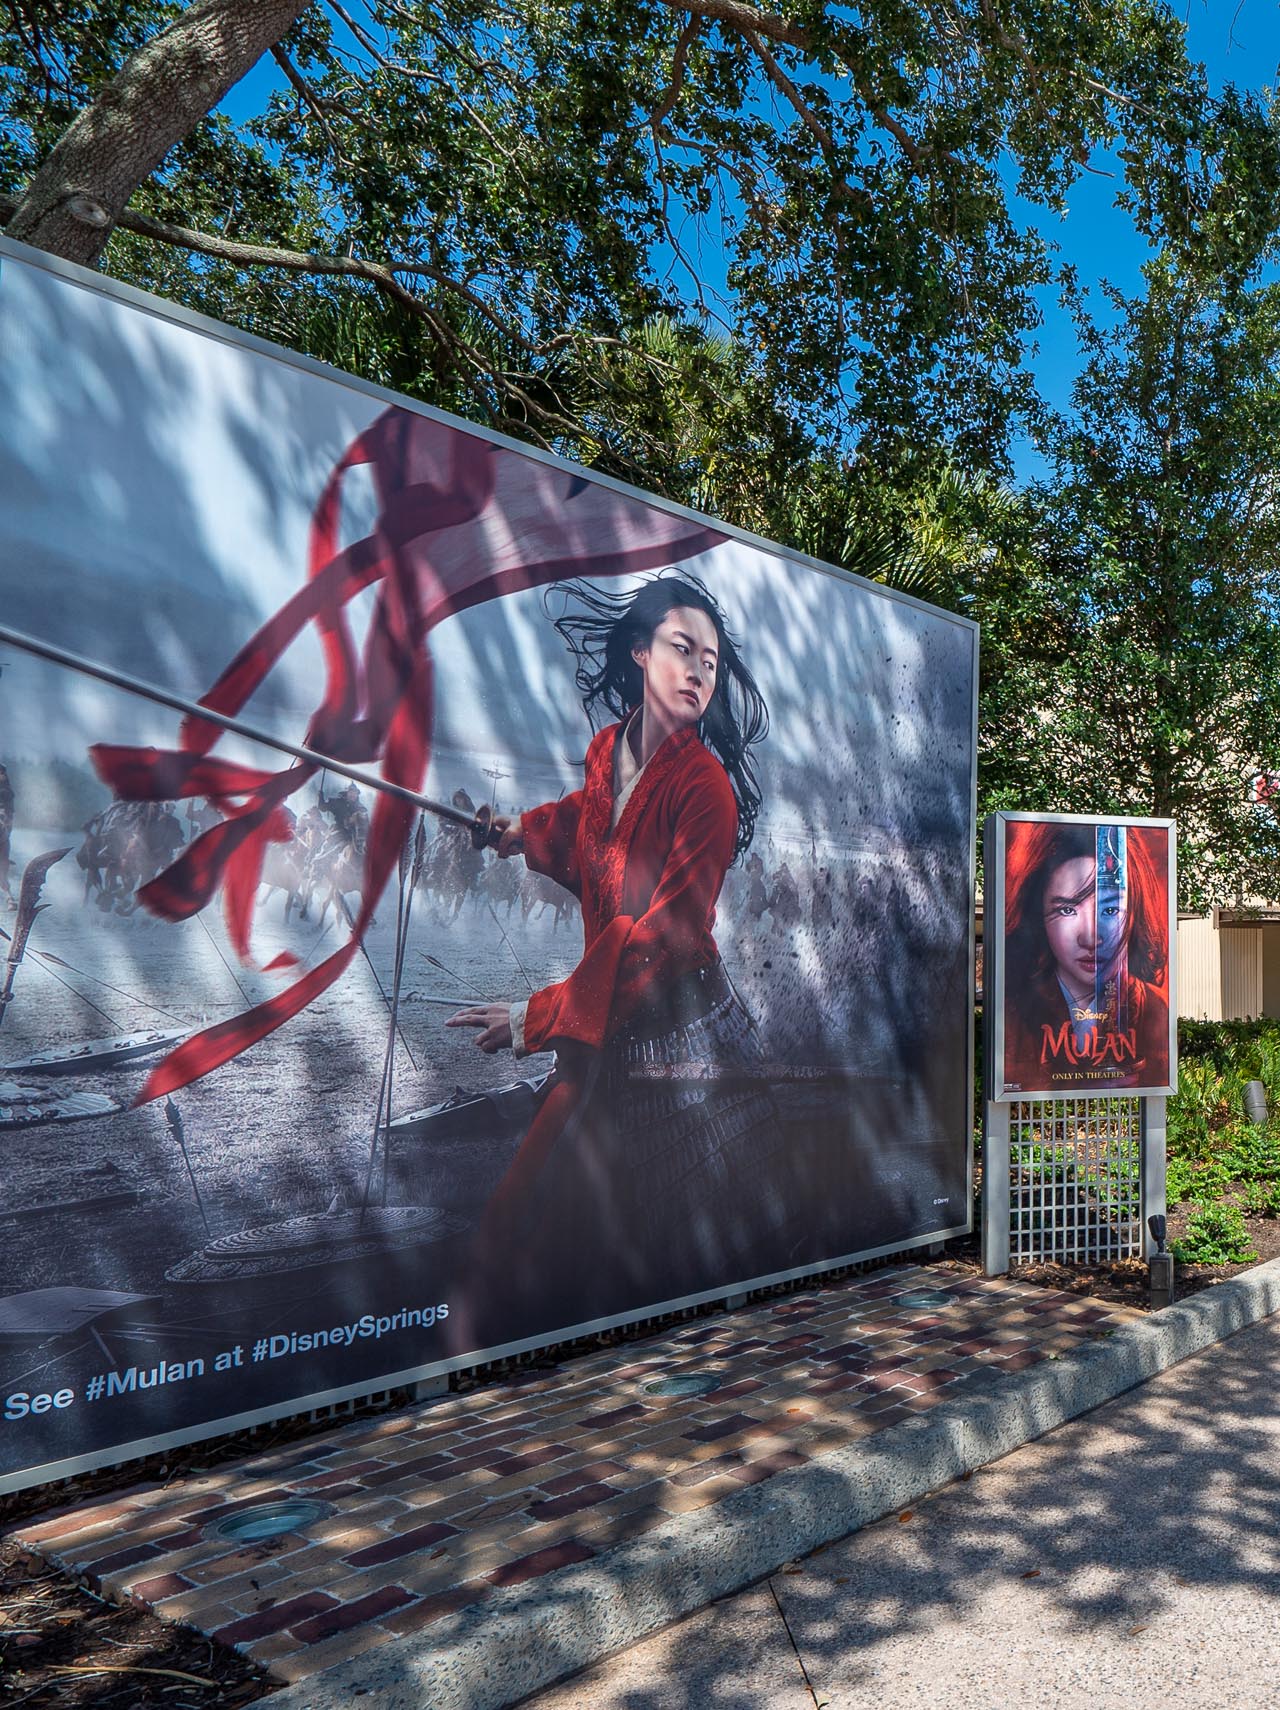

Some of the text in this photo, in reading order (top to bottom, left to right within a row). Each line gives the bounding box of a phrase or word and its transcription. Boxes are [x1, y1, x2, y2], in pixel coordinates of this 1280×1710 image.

[1071, 1008, 1109, 1023] Disney
[1051, 1071, 1126, 1081] ONLY IN THEATRES
[3, 1302, 450, 1421] See #Mulan at #DisneySprings
